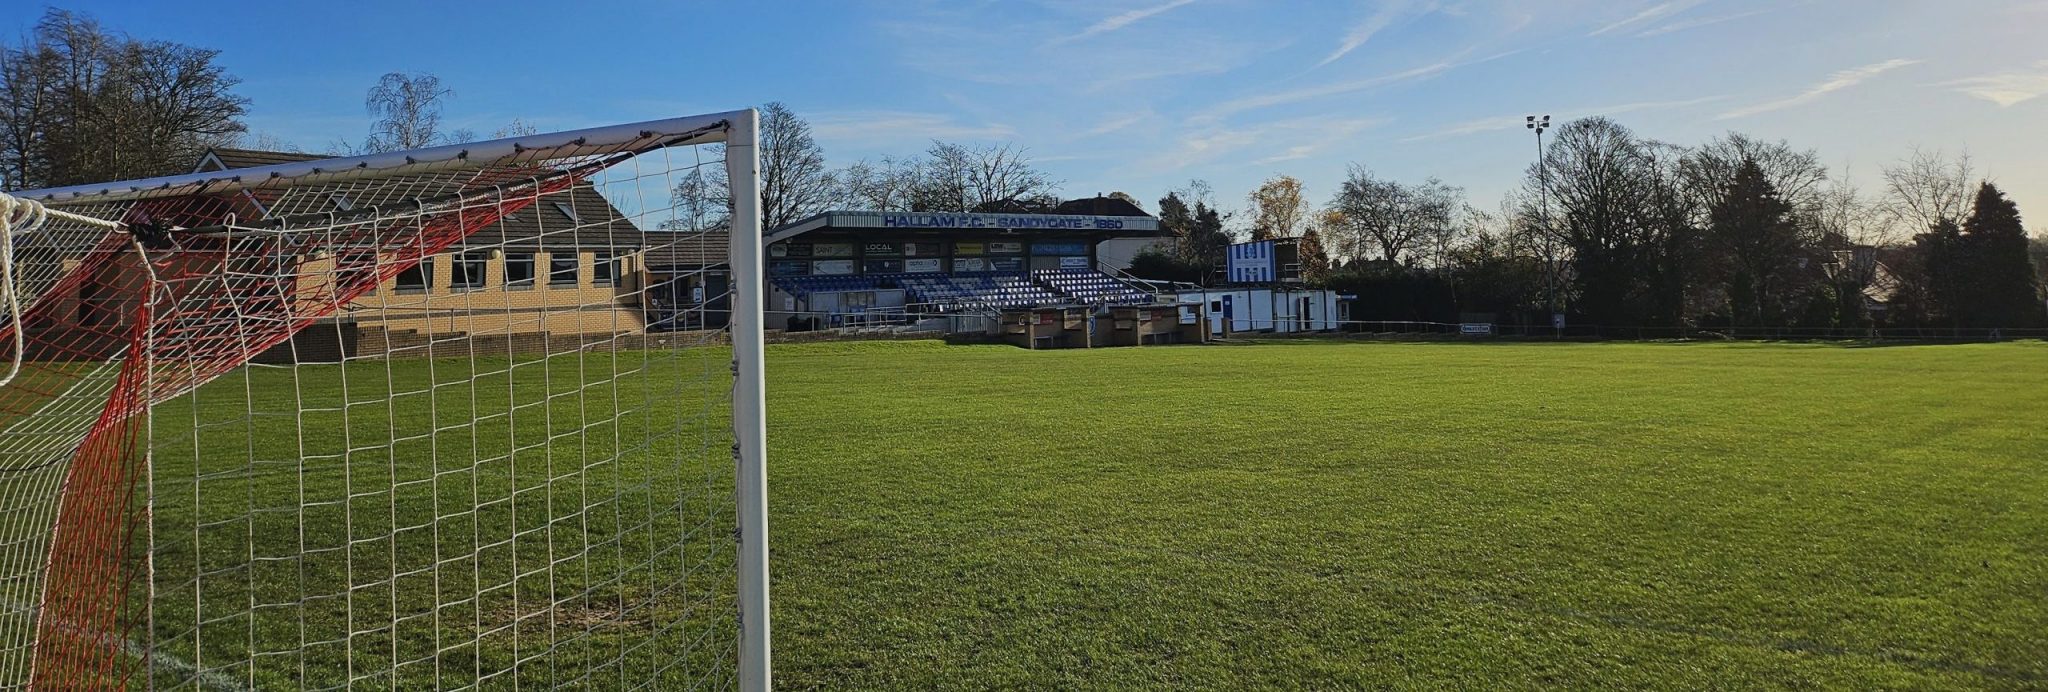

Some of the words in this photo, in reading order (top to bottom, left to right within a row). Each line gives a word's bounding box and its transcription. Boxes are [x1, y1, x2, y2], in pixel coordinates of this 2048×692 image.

[885, 215, 955, 227] HALLAM
[959, 216, 985, 227] F.C.
[997, 217, 1082, 228] SANDYGATE
[1093, 219, 1123, 229] 1860
[815, 246, 832, 254] SAINT
